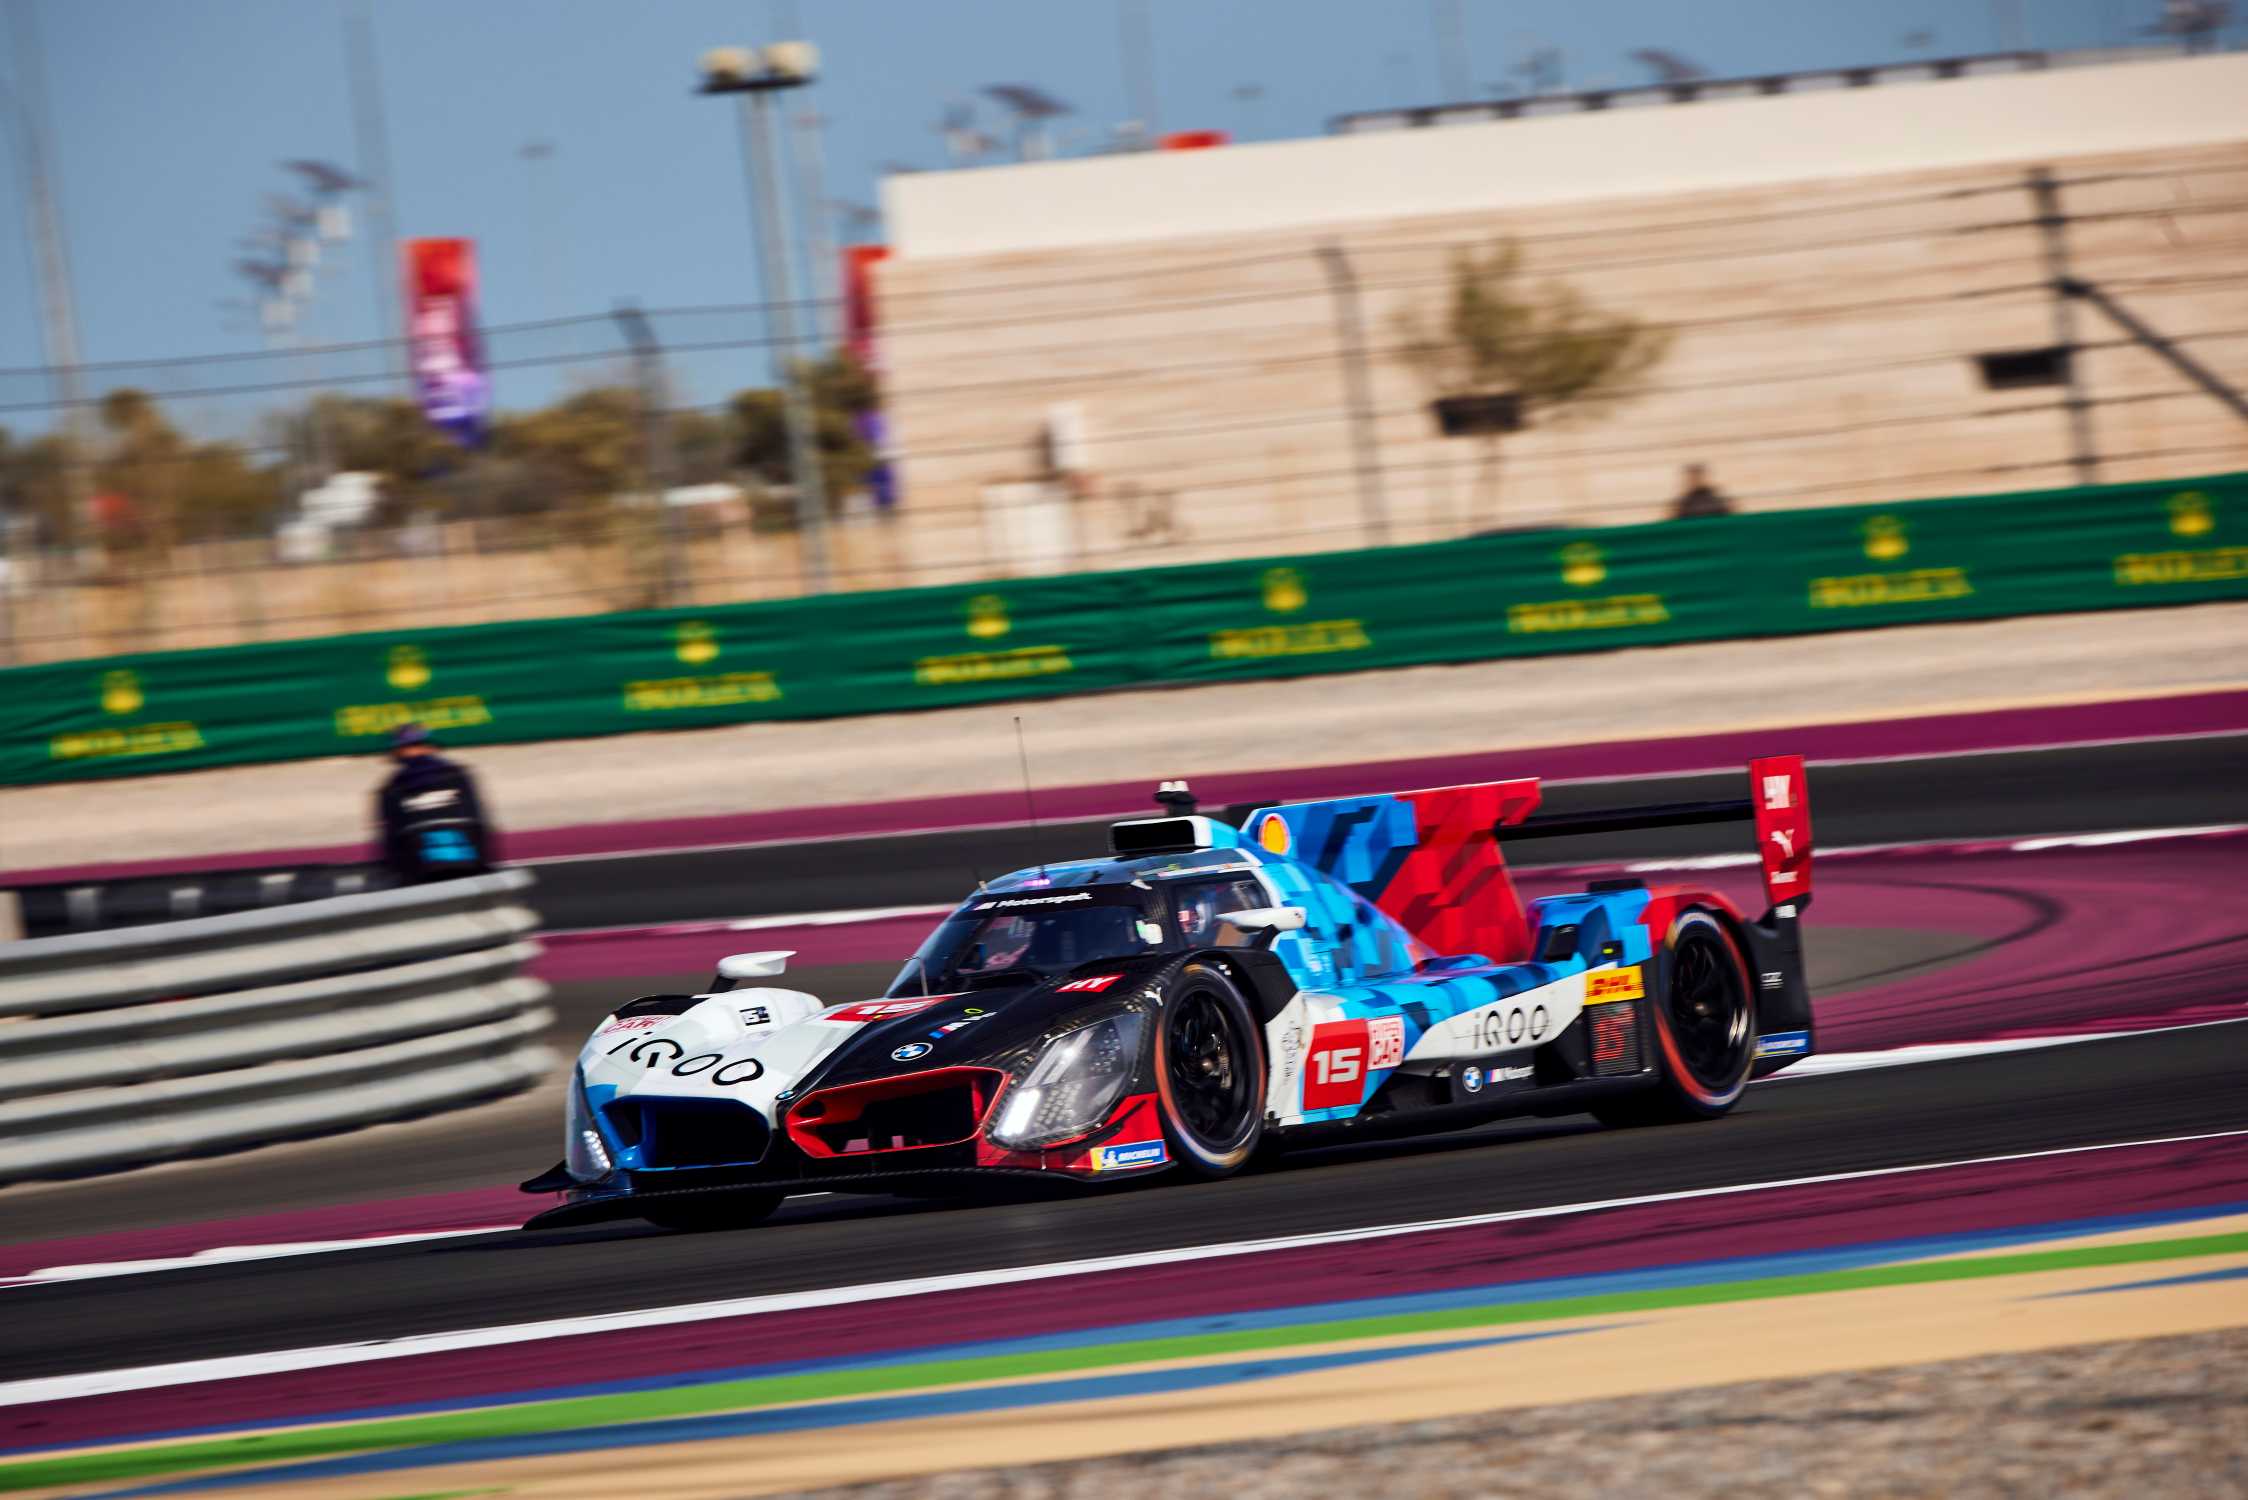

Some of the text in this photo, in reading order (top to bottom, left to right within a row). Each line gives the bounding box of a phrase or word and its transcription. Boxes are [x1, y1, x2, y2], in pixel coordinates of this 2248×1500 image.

[1058, 976, 1120, 991] HY
[1472, 1003, 1549, 1050] iQOO
[606, 1031, 765, 1086] iQOO
[1312, 1047, 1362, 1085] 15
